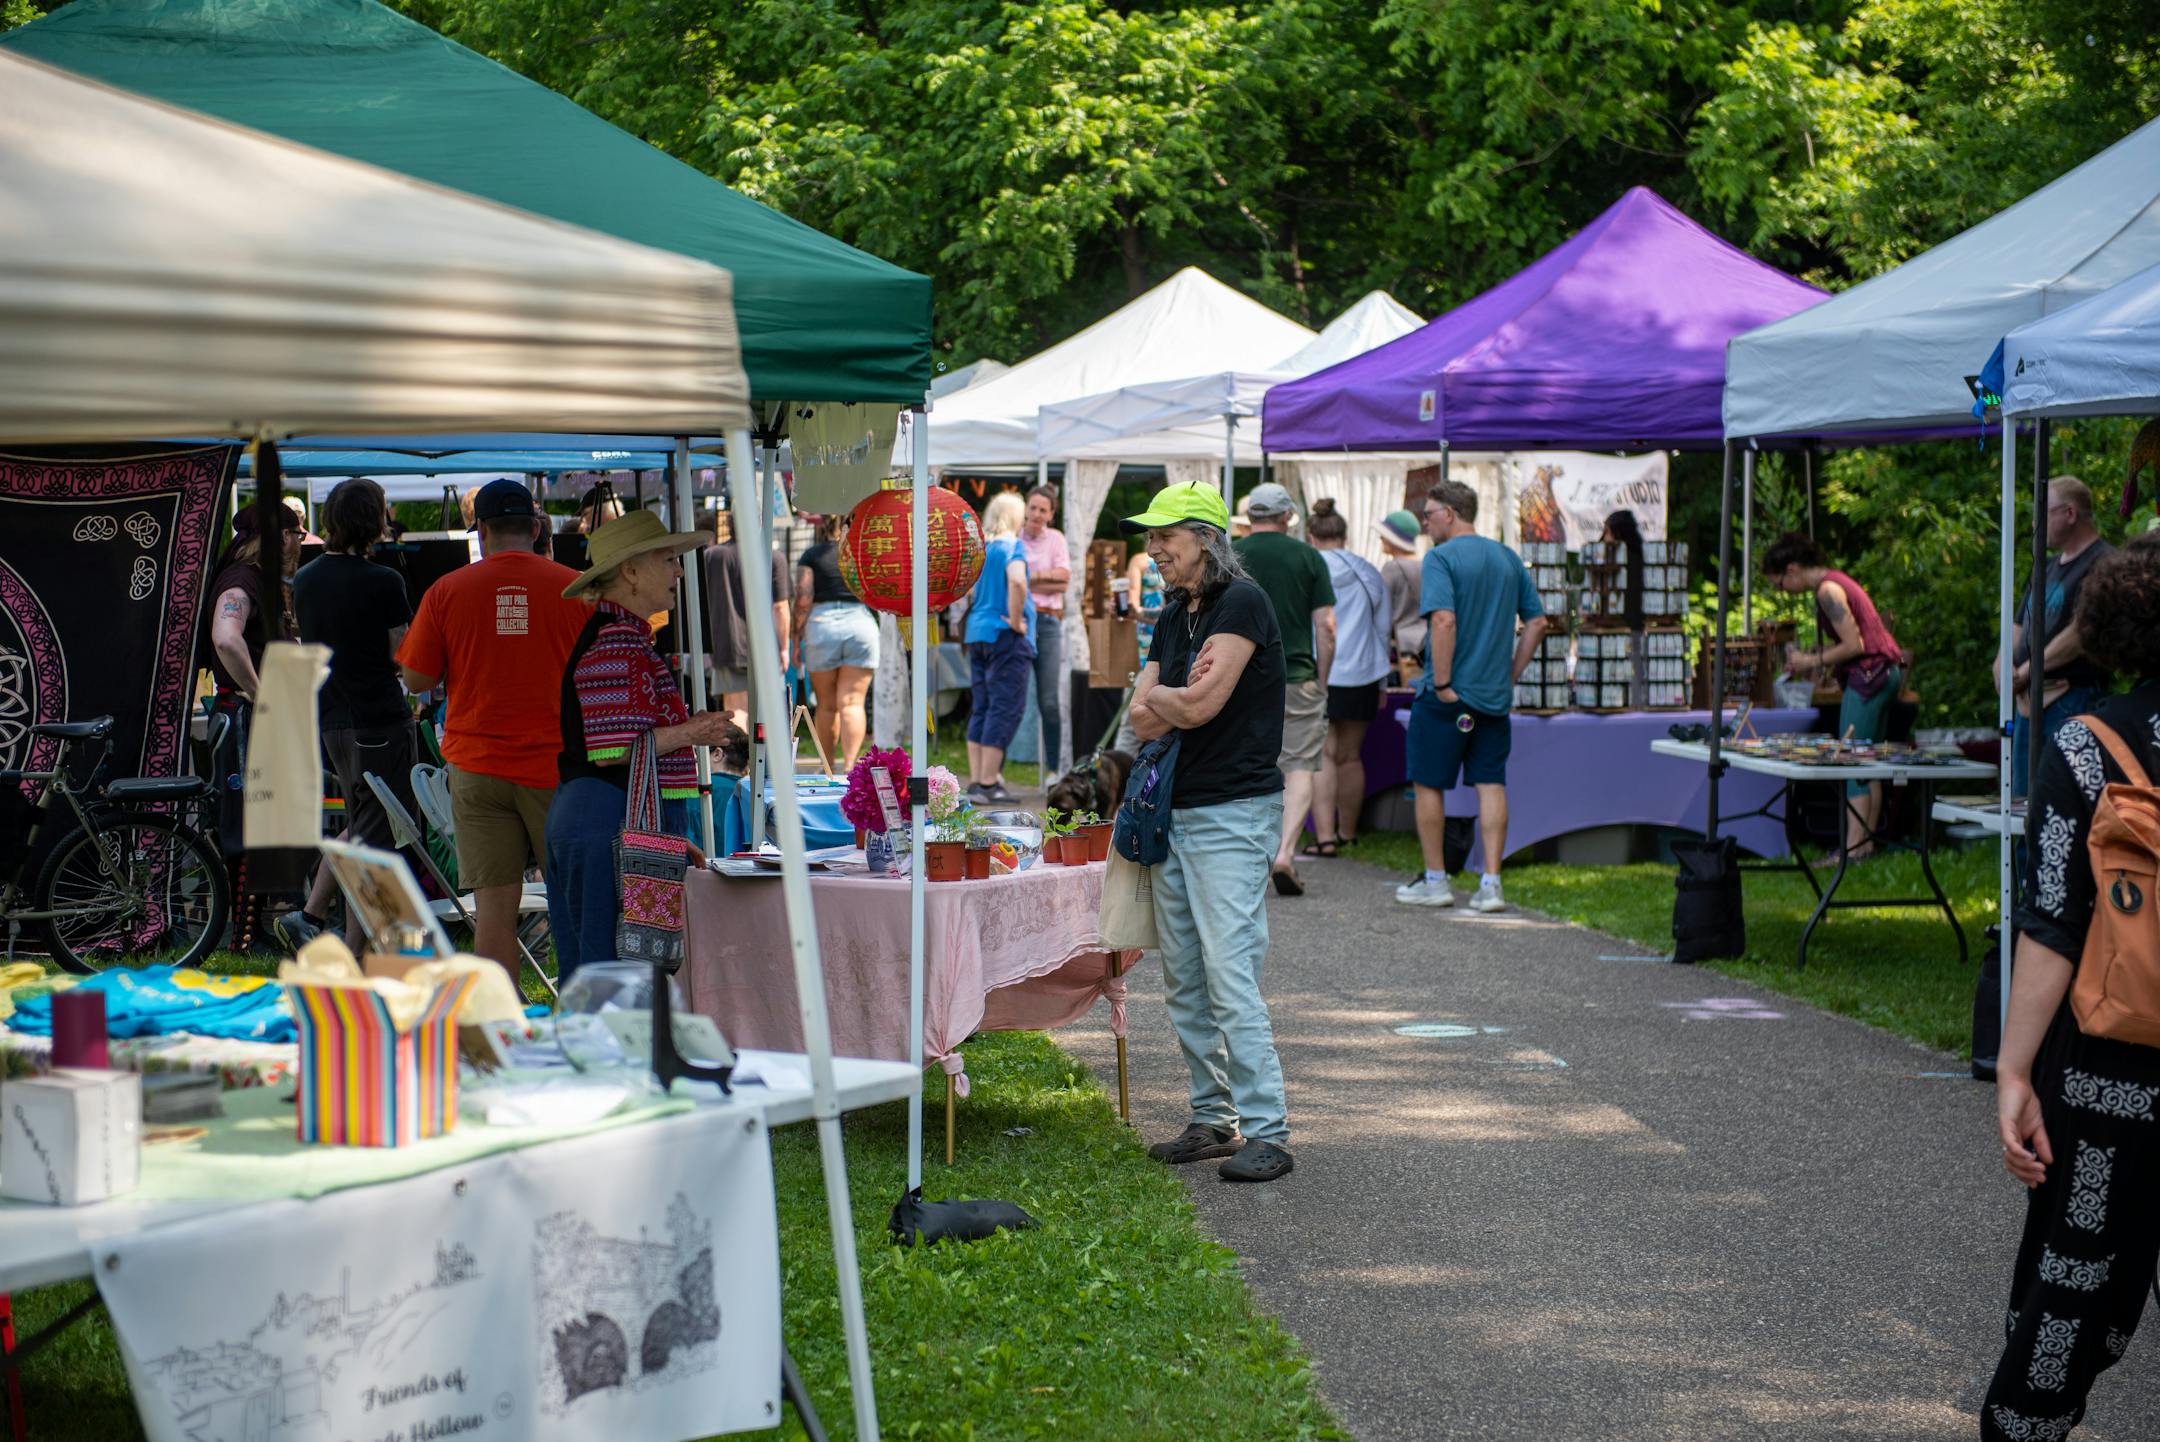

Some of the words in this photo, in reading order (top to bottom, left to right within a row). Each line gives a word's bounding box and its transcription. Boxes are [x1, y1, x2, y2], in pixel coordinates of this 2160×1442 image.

[496, 594, 513, 605] SAINT
[514, 594, 528, 605] PAUL
[496, 606, 508, 618] ART
[496, 618, 528, 630] COLLECTIVE
[361, 1373, 439, 1412] Friends
[444, 1367, 468, 1393] of
[410, 1413, 485, 1441] Hollow
